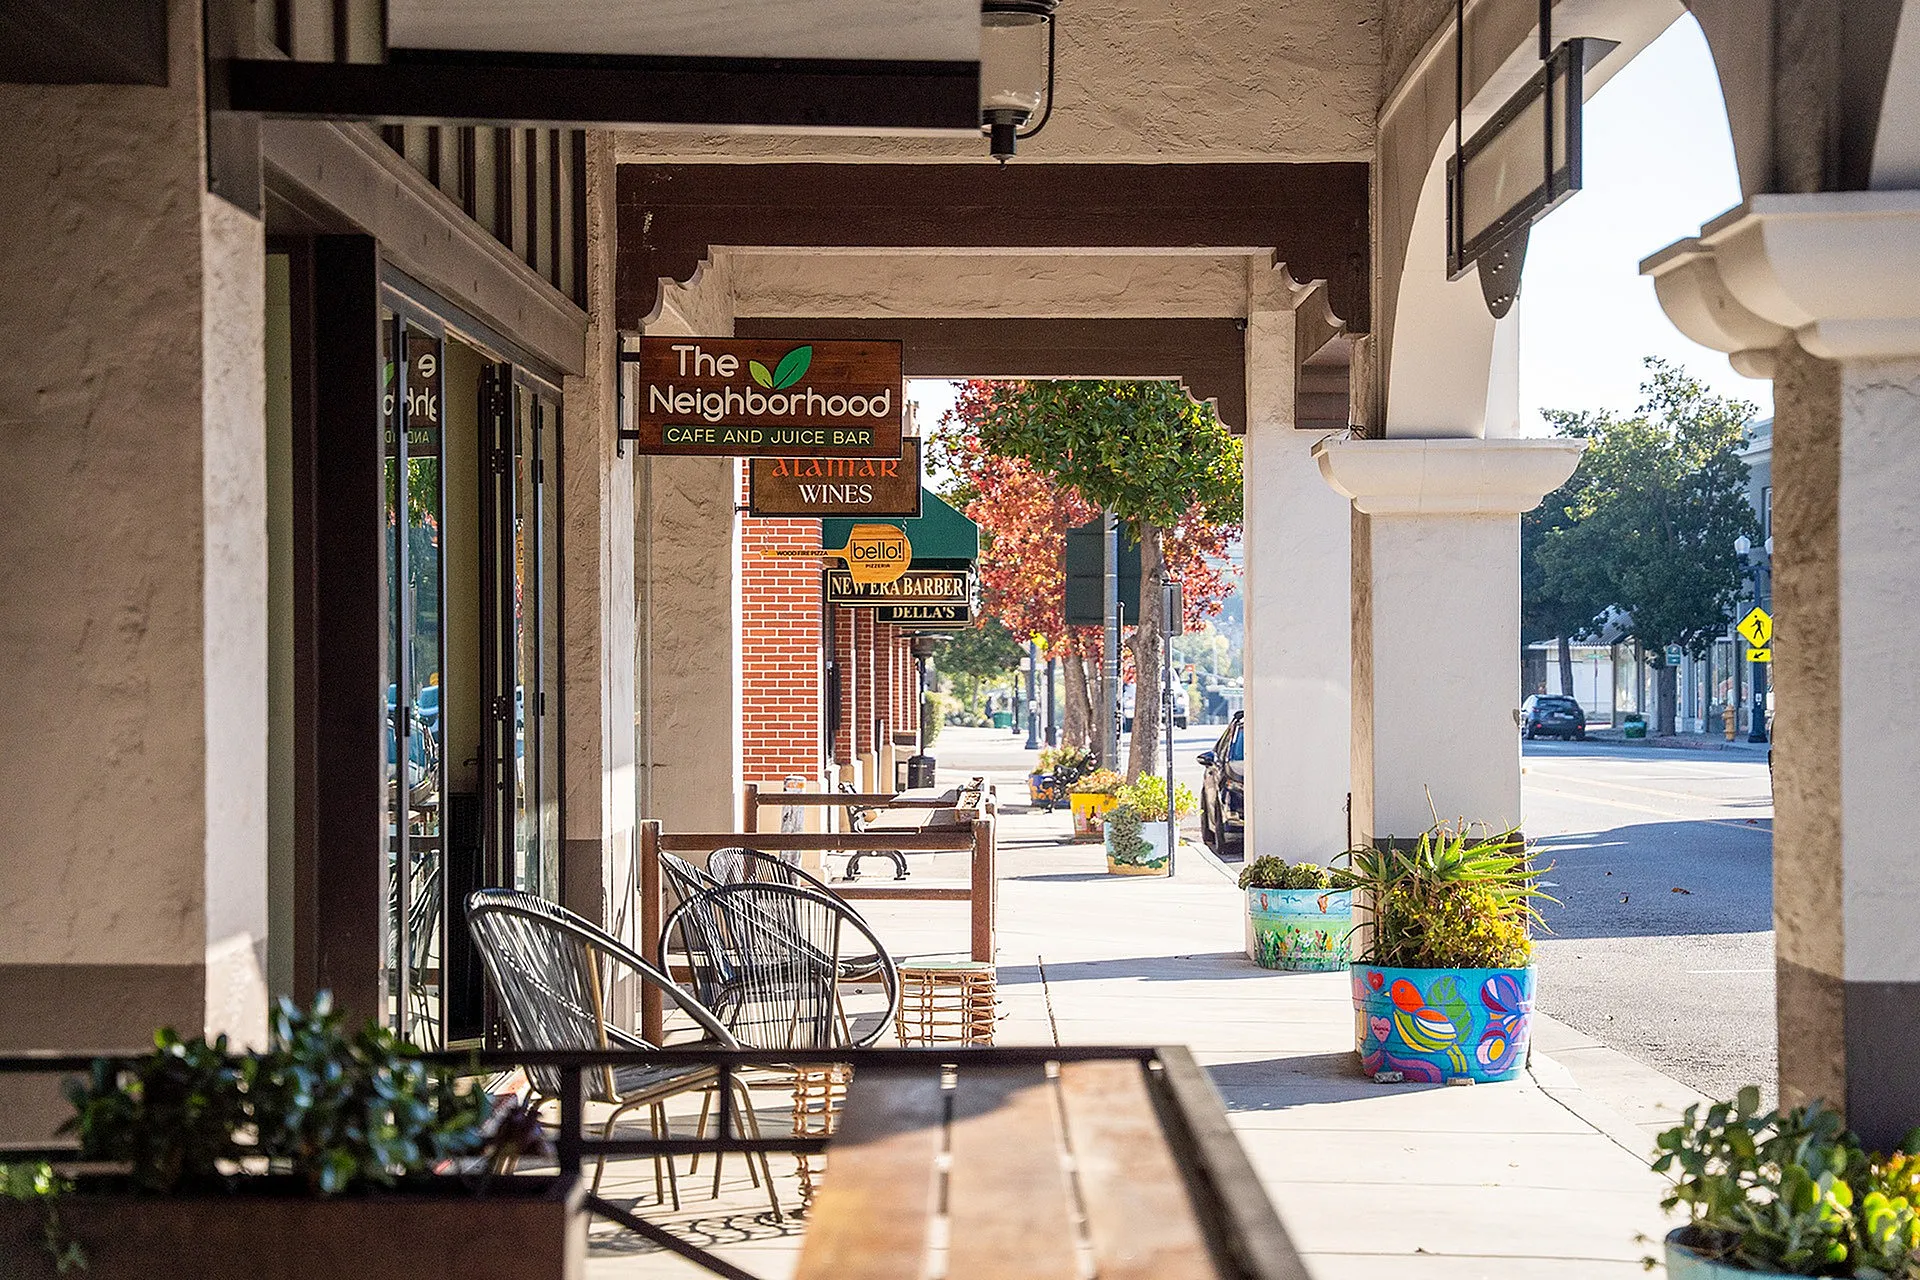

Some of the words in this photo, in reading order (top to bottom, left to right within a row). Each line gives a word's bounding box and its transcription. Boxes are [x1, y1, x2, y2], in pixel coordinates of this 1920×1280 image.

[671, 344, 739, 378] The
[649, 384, 891, 422] Neighborhood
[667, 428, 715, 443] CAFE
[723, 430, 763, 443] AND
[770, 430, 824, 444] JUICE
[833, 431, 870, 445] BAR
[799, 484, 873, 504] WINES
[853, 541, 902, 560] bello!
[831, 576, 865, 595] NEW
[870, 578, 900, 596] ERA
[903, 577, 964, 596] BARBER
[892, 606, 955, 619] DELLA'S
